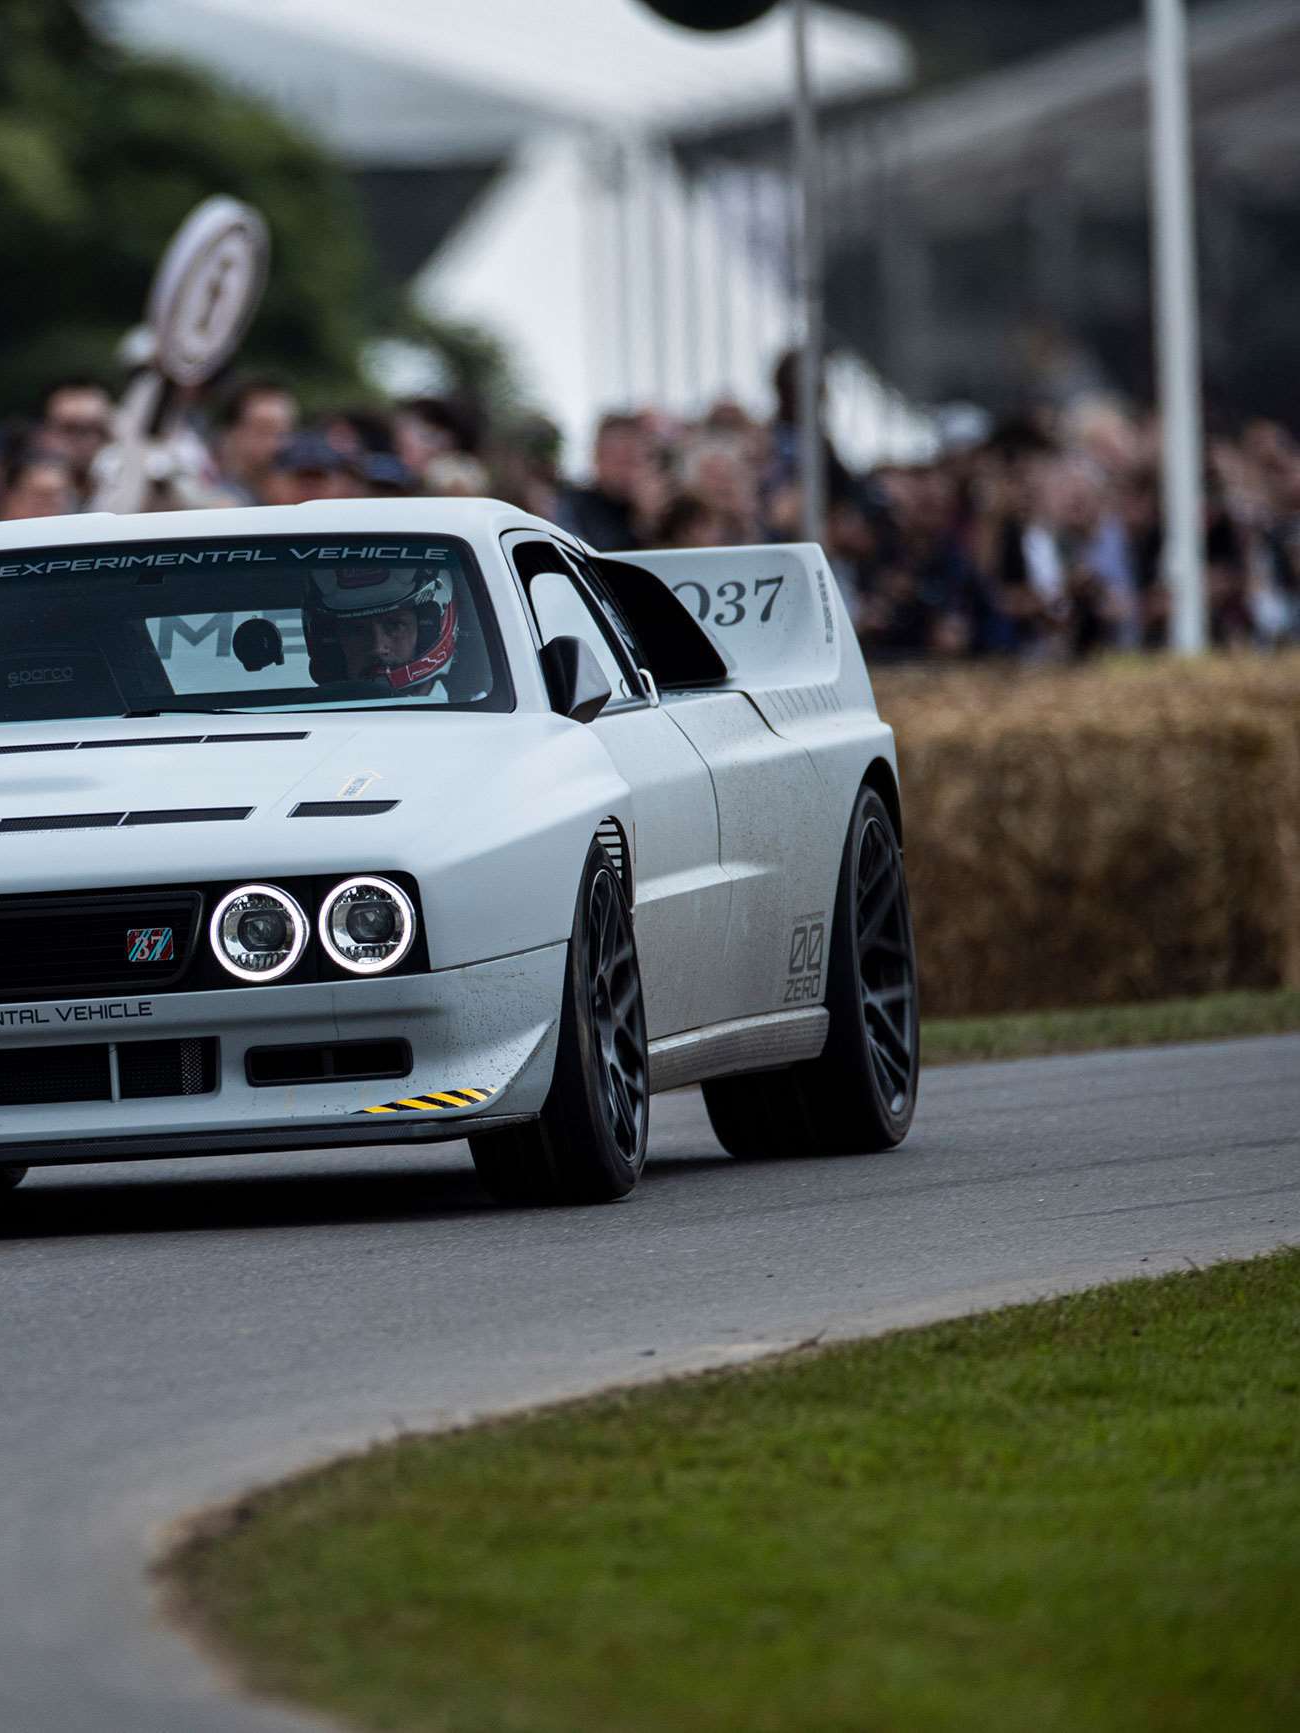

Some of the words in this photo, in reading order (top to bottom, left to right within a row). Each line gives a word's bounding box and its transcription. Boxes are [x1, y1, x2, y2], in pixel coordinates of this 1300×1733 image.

[289, 547, 449, 560] VEHICLE
[8, 665, 73, 687] sparco
[783, 974, 820, 1003] ZERO
[55, 1001, 153, 1022] VEHICLE
